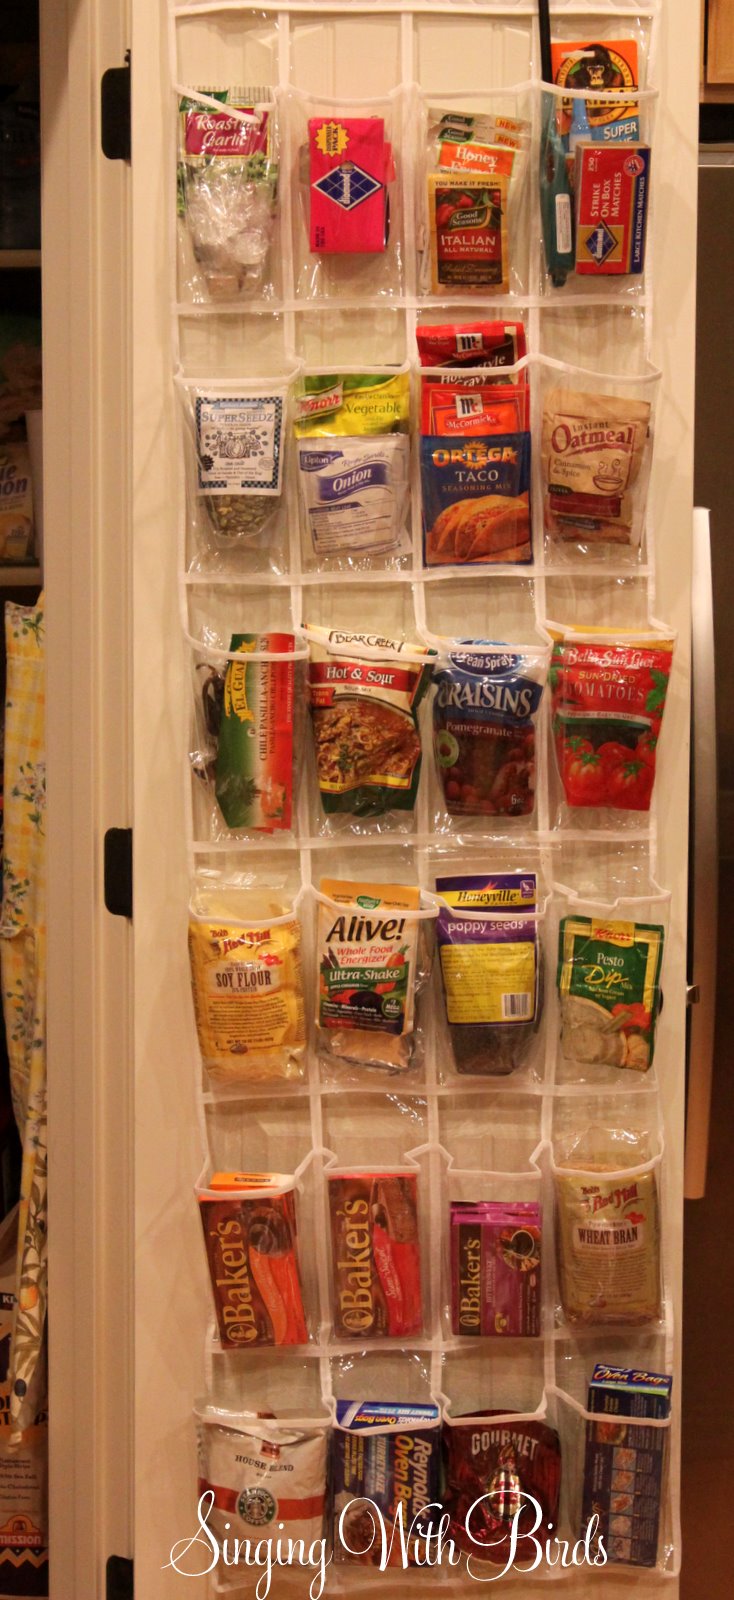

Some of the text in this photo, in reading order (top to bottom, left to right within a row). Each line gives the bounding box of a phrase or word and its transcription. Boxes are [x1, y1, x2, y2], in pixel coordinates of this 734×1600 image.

[196, 114, 258, 131] Roast
[604, 121, 638, 140] SUPER
[203, 131, 246, 147] Garlic
[456, 146, 498, 167] Honey
[590, 182, 600, 217] STRIKE
[612, 172, 622, 217] MATCHES
[637, 176, 645, 208] MATCHES
[452, 218, 482, 226] Seasons
[456, 210, 478, 220] Good
[441, 235, 496, 246] ITALIAN
[346, 402, 401, 415] Vegetable
[447, 414, 492, 430] McCormick
[573, 422, 609, 432] Instant
[552, 424, 634, 454] Oatmeal
[304, 455, 329, 465] Lipton
[432, 446, 517, 468] ORTEGA
[332, 468, 372, 492] Onion
[455, 470, 499, 482] TACO
[335, 634, 398, 650] BEAR CREEK
[485, 654, 515, 671] Spray
[326, 666, 395, 685] Hot & Sour
[234, 694, 246, 712] EL
[260, 659, 269, 730] PASILLA-ANCH
[438, 681, 533, 718] CRAISINS
[446, 722, 513, 737] Pomegranate
[260, 732, 268, 760] CHILE
[457, 890, 517, 902] Honeyville
[326, 916, 406, 943] Alive!
[448, 920, 524, 934] poppy seeds
[336, 945, 394, 956] Whole Food
[597, 952, 625, 967] Pesto
[340, 955, 388, 966] Energizer
[216, 970, 272, 988] SOY FLOUR
[329, 969, 401, 982] Ultra-Shake
[581, 964, 629, 989] Dip
[578, 1227, 638, 1245] WHEAT BRAN
[336, 1200, 374, 1310] Baker's
[210, 1220, 256, 1325] Baker's
[460, 1238, 481, 1312] Baker's
[594, 1368, 630, 1381] Oven
[471, 1429, 539, 1461] GOURMET
[235, 1455, 294, 1472] HOUSE BLEND
[394, 1435, 414, 1481] Oven
[409, 1438, 432, 1519] Reynolds
